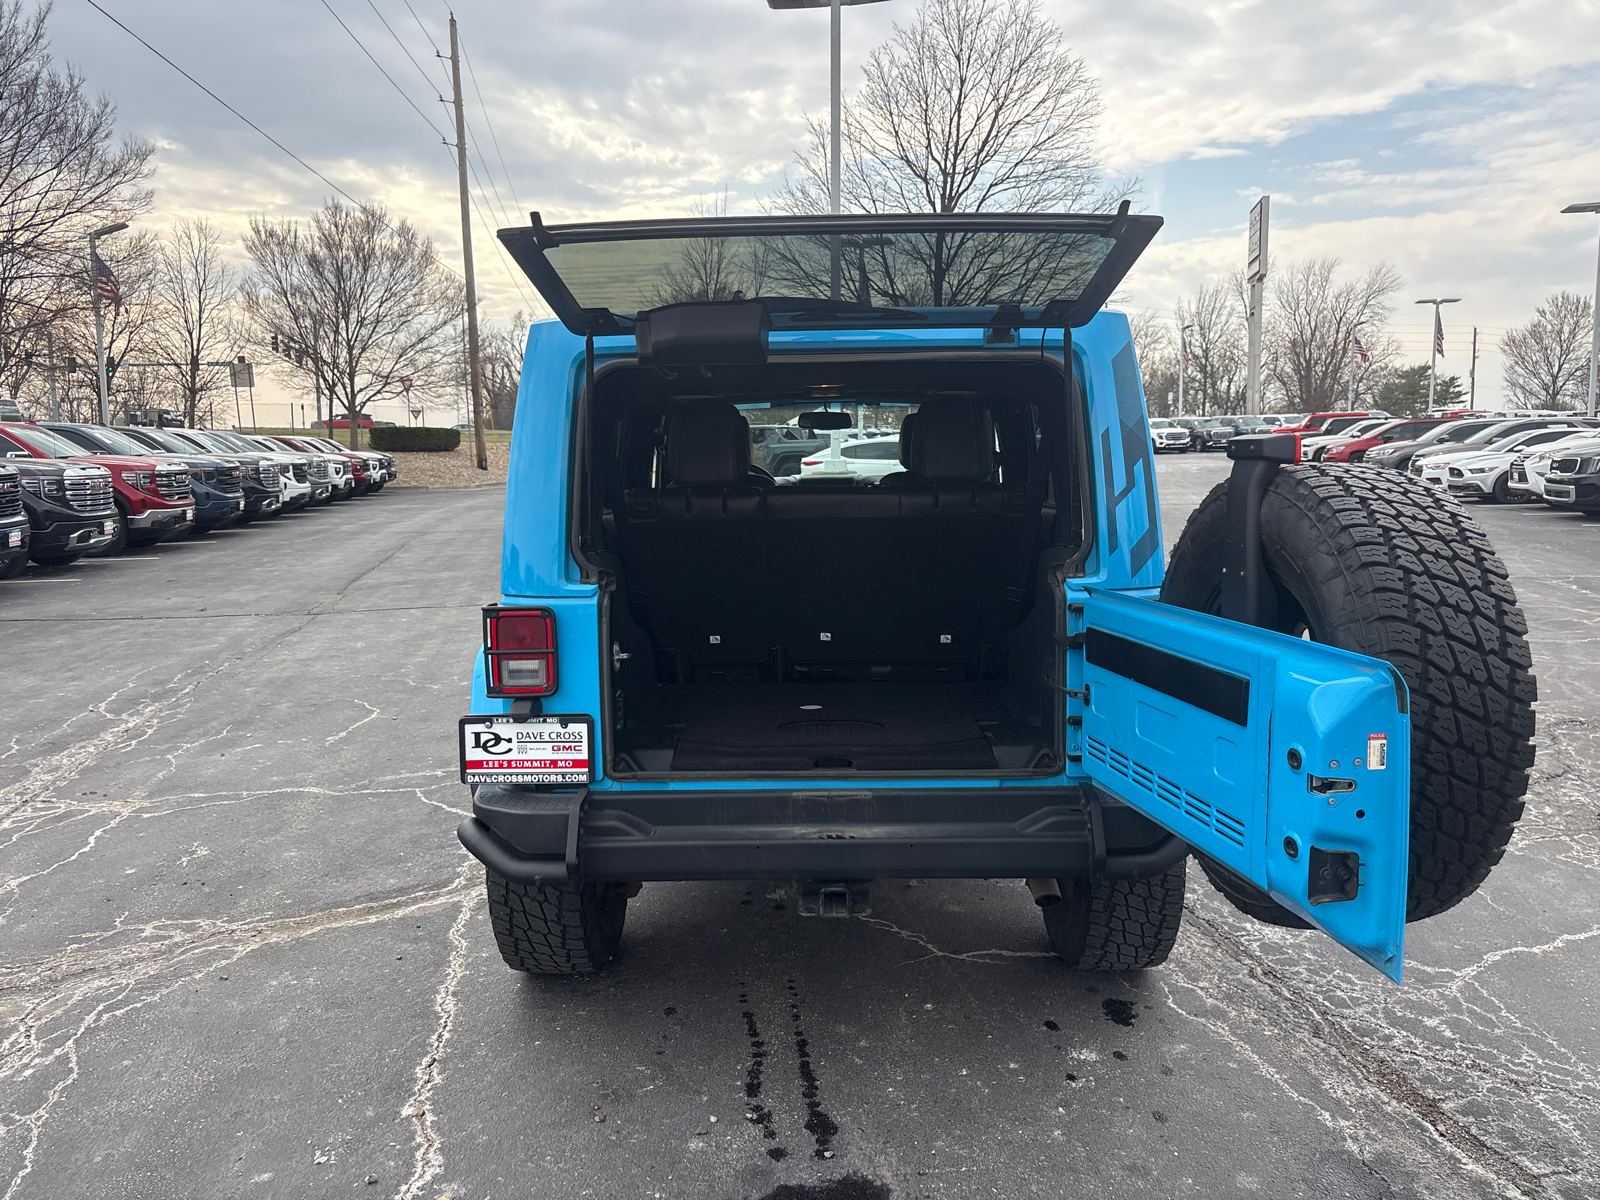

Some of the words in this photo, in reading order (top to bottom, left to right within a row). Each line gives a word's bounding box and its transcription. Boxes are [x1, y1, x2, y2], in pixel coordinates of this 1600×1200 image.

[516, 731, 546, 740] DAVE
[548, 731, 583, 740] CROSS
[471, 731, 513, 755] DC
[482, 760, 508, 768] LEE'S
[511, 760, 554, 769] SUMMIT,
[556, 760, 573, 768] MO
[467, 773, 588, 783] DAVECROSSMOTORS.COM
